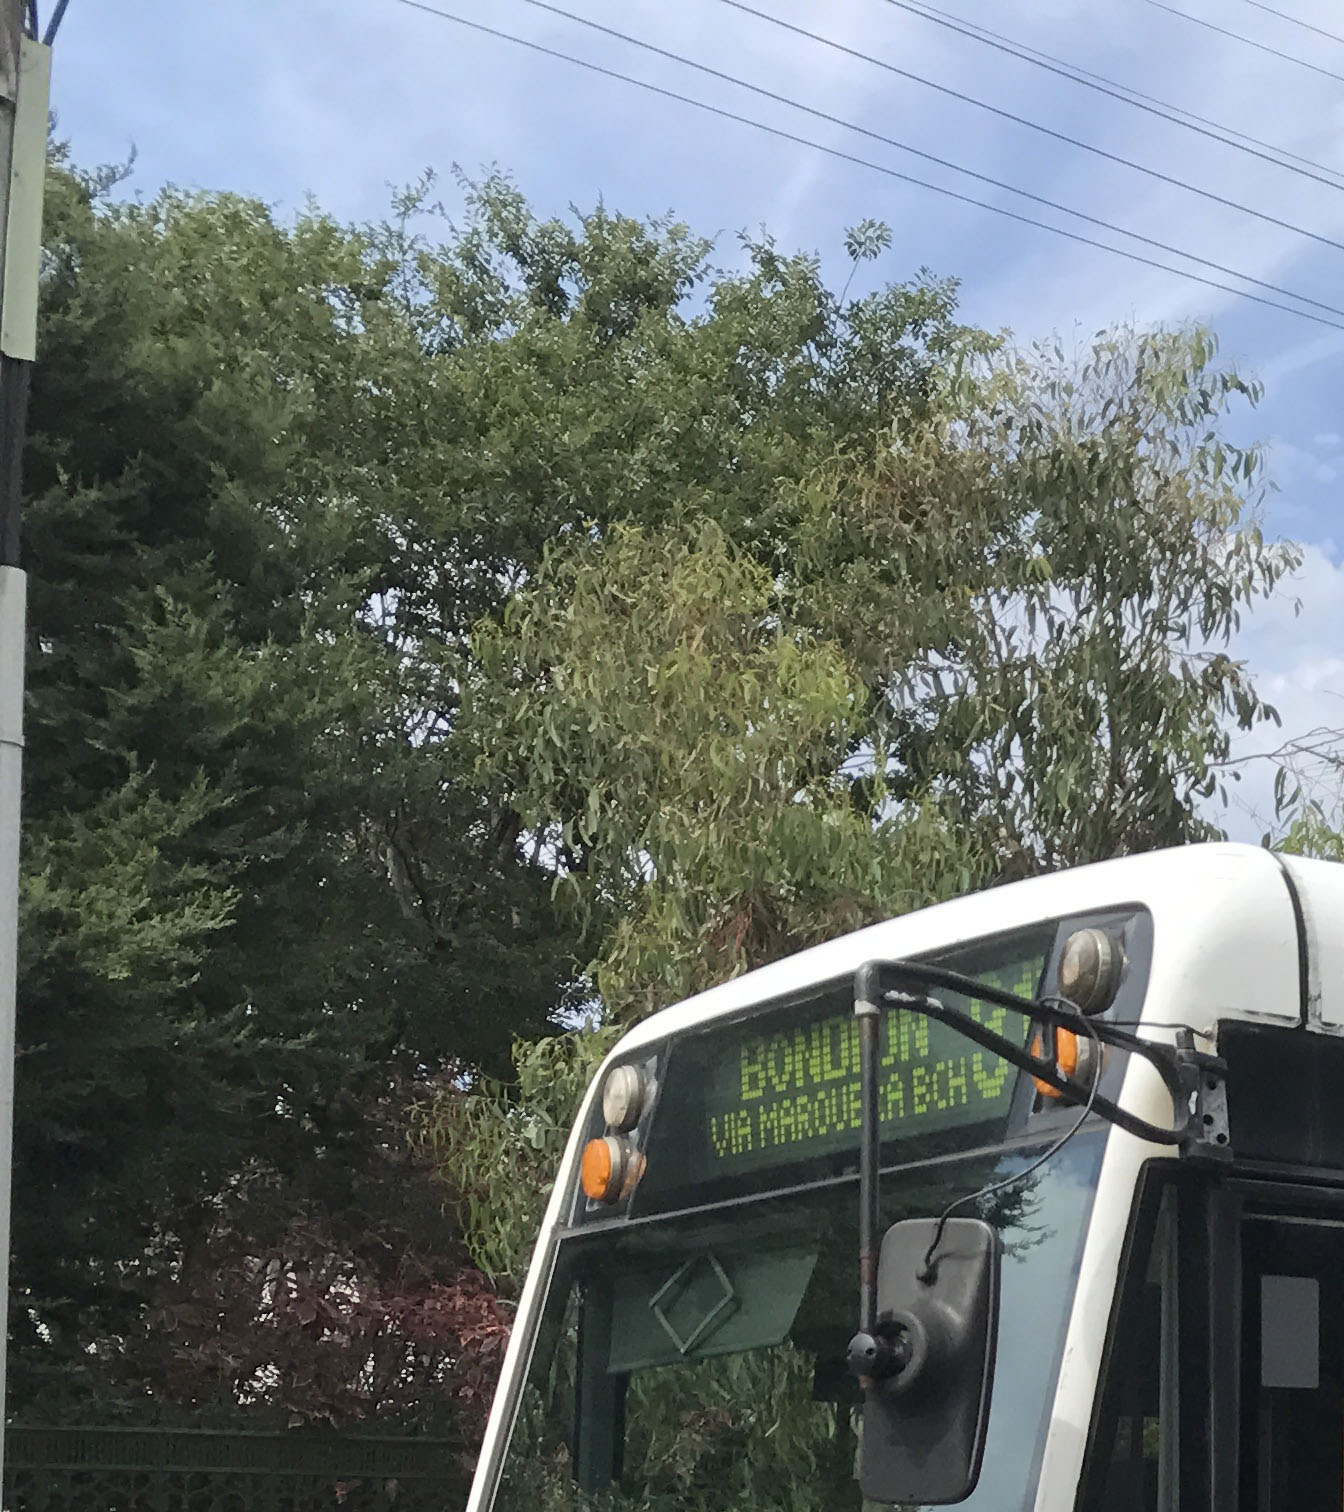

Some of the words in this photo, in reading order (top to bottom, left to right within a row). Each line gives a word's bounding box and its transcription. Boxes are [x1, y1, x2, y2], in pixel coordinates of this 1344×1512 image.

[740, 1017, 861, 1101] BONDI
[711, 1109, 752, 1157] VIA
[912, 1056, 967, 1114] BCH
